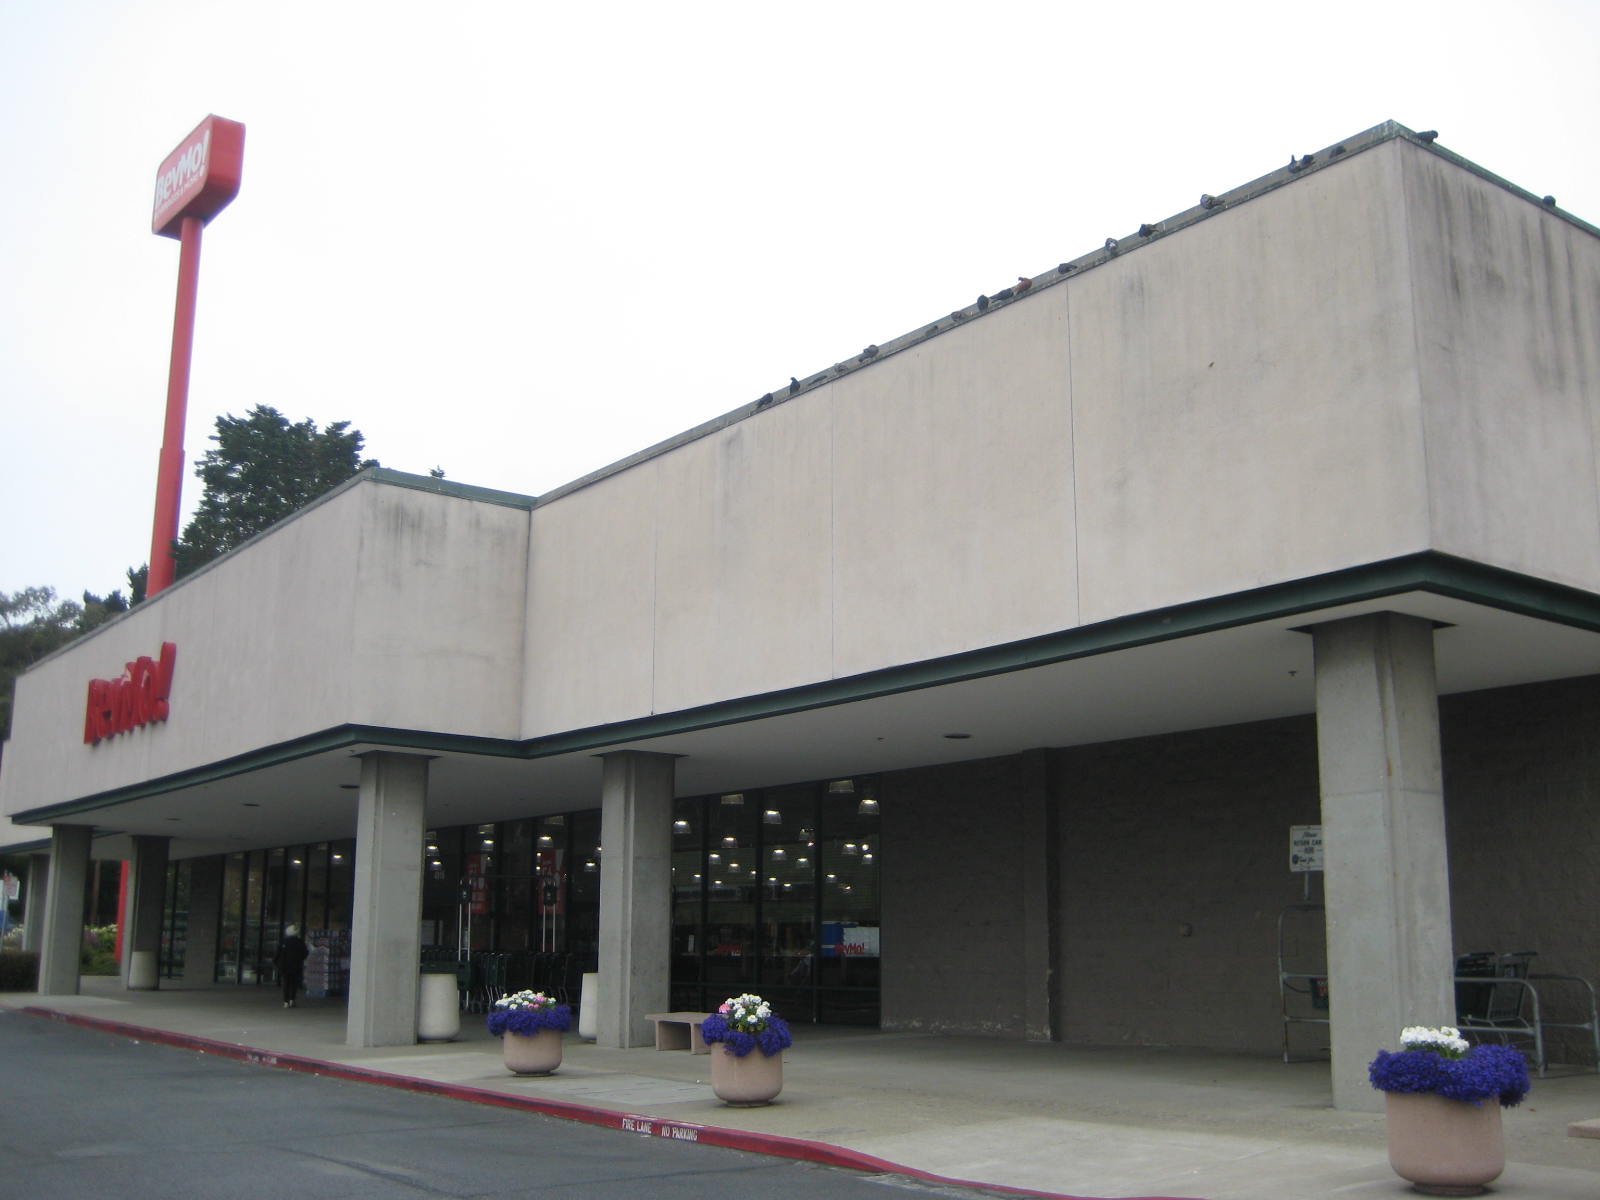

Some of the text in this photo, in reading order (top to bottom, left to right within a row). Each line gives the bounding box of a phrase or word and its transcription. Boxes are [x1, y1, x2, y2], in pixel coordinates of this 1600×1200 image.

[622, 1118, 698, 1141] FIRE LANE NO PARKING
